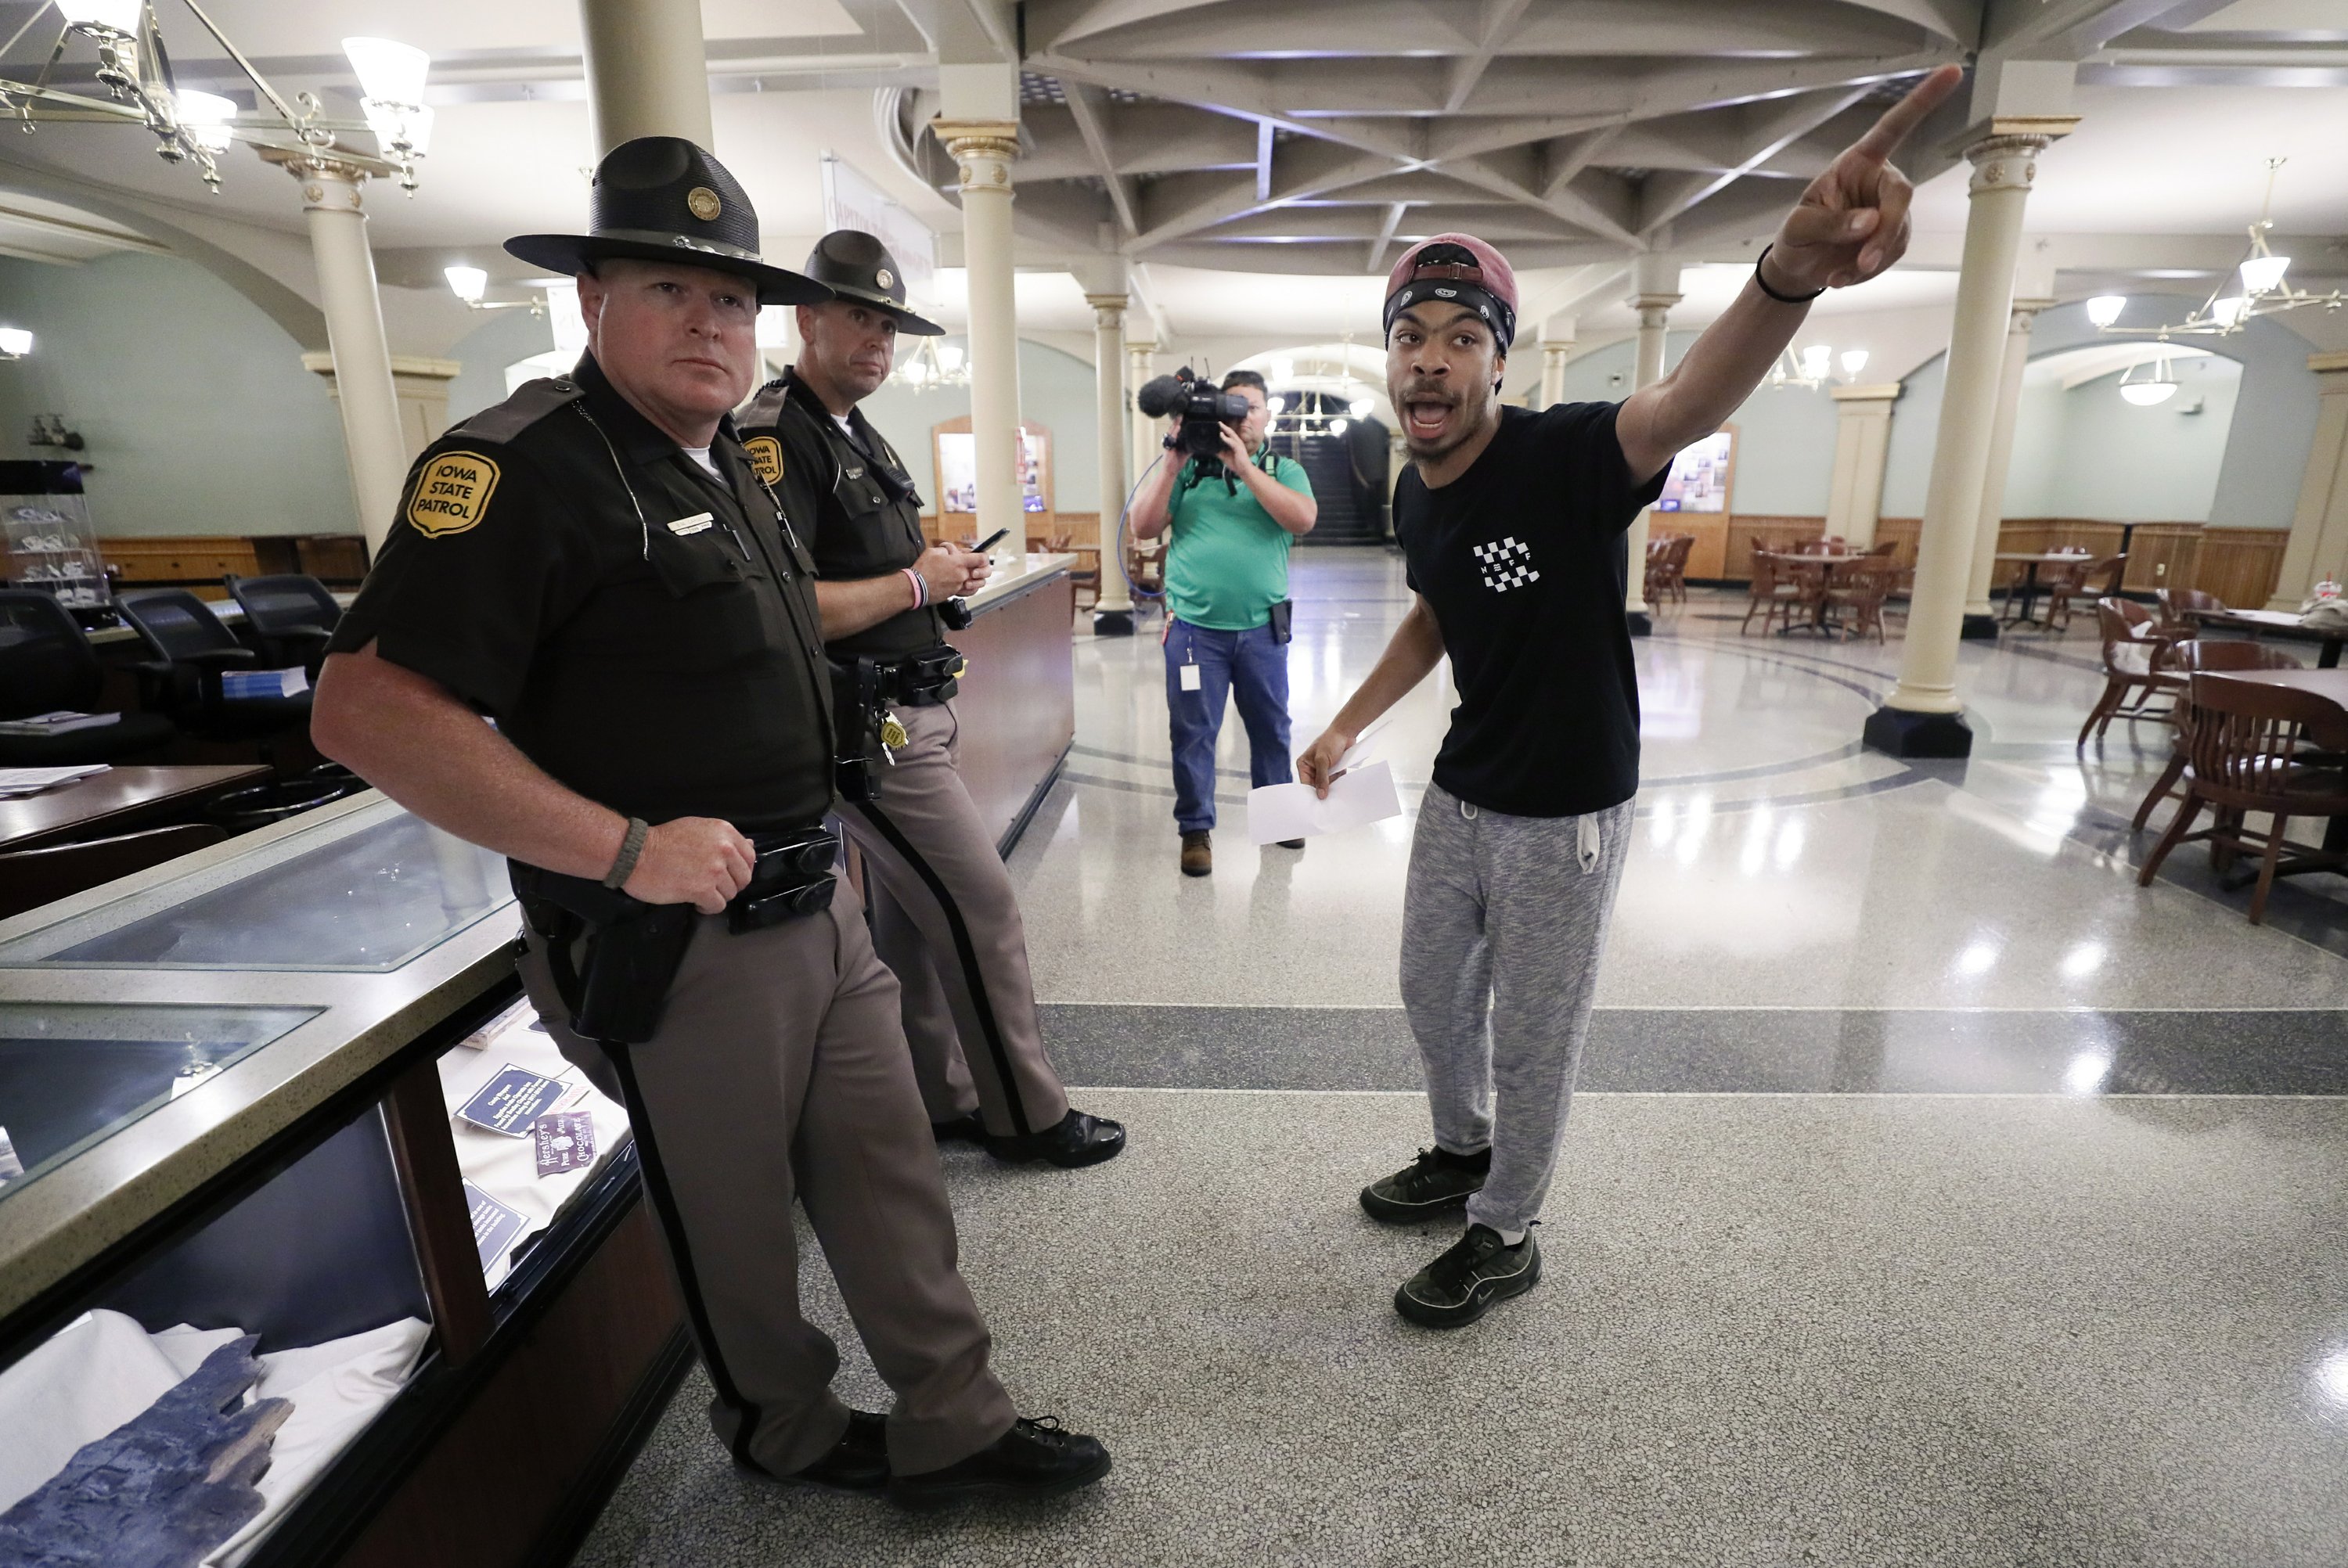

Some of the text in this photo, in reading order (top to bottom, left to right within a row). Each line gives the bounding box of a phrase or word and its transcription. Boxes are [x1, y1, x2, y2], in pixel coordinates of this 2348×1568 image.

[436, 466, 477, 483] IOWA
[754, 466, 776, 475] TROL
[429, 481, 474, 499] STATE
[416, 499, 470, 519] PATROL
[540, 1124, 559, 1166] Hershey's
[573, 1117, 589, 1161] CHOCOLATE
[561, 1152, 570, 1167] PURE
